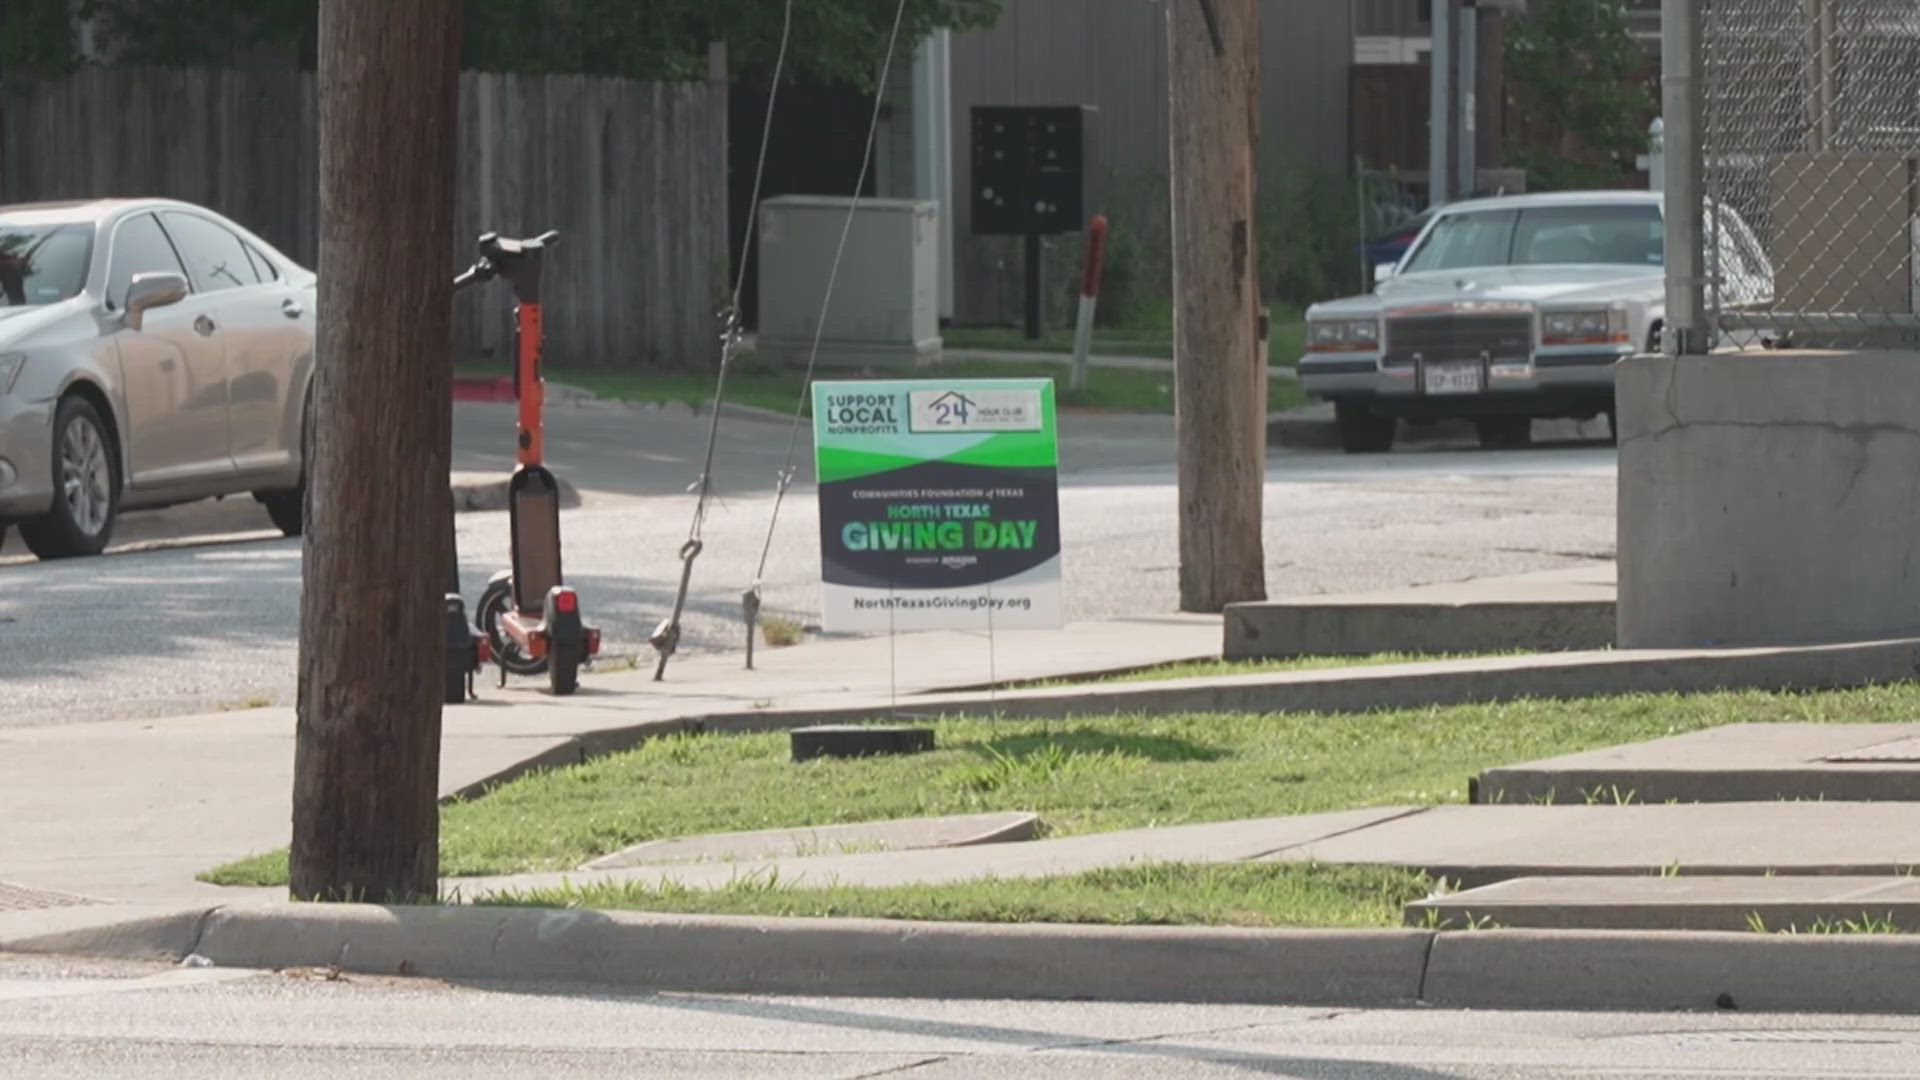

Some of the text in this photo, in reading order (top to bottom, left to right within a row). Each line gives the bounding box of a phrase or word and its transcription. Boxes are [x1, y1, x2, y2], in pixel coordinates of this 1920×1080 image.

[827, 394, 896, 407] SUPPORT
[827, 408, 898, 424] LOCAL
[934, 394, 969, 425] 24
[827, 425, 899, 435] NONPROFITS
[852, 489, 919, 498] COMMUNITIES
[920, 489, 983, 498] FOUNDATION
[996, 488, 1024, 498] TEXAS
[887, 504, 991, 519] NORTH TEXAS
[841, 520, 1038, 551] GIVING DAY
[853, 596, 1032, 611] NorthTexasGivingDay.org
